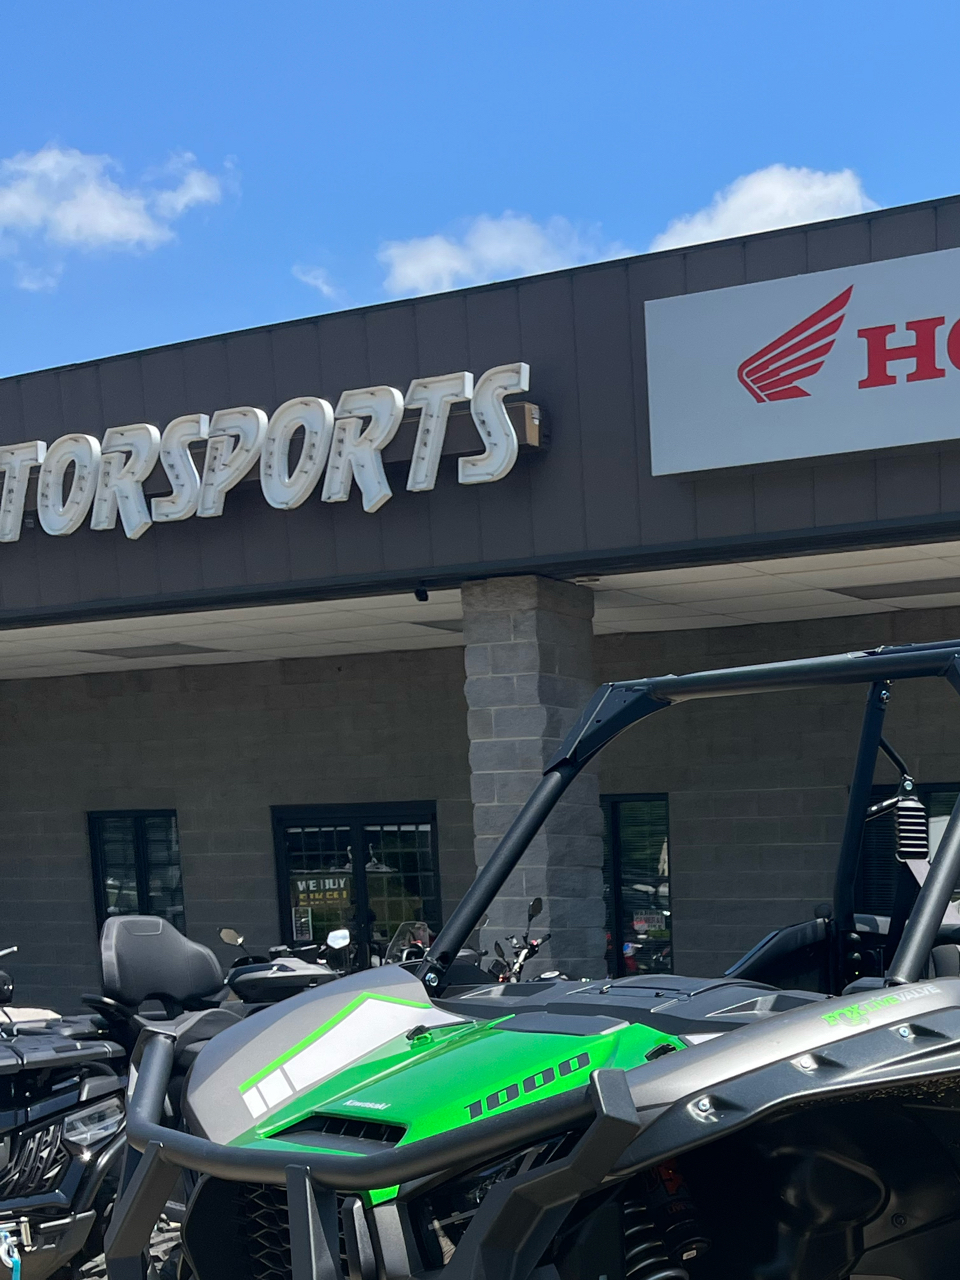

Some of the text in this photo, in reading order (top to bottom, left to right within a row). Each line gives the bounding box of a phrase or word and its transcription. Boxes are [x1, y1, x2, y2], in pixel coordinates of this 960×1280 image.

[297, 880, 317, 891] WE
[821, 1004, 868, 1026] FOX
[895, 983, 942, 1001] VALVE
[464, 1052, 591, 1120] 1000
[342, 1099, 391, 1110] Kawasaki
